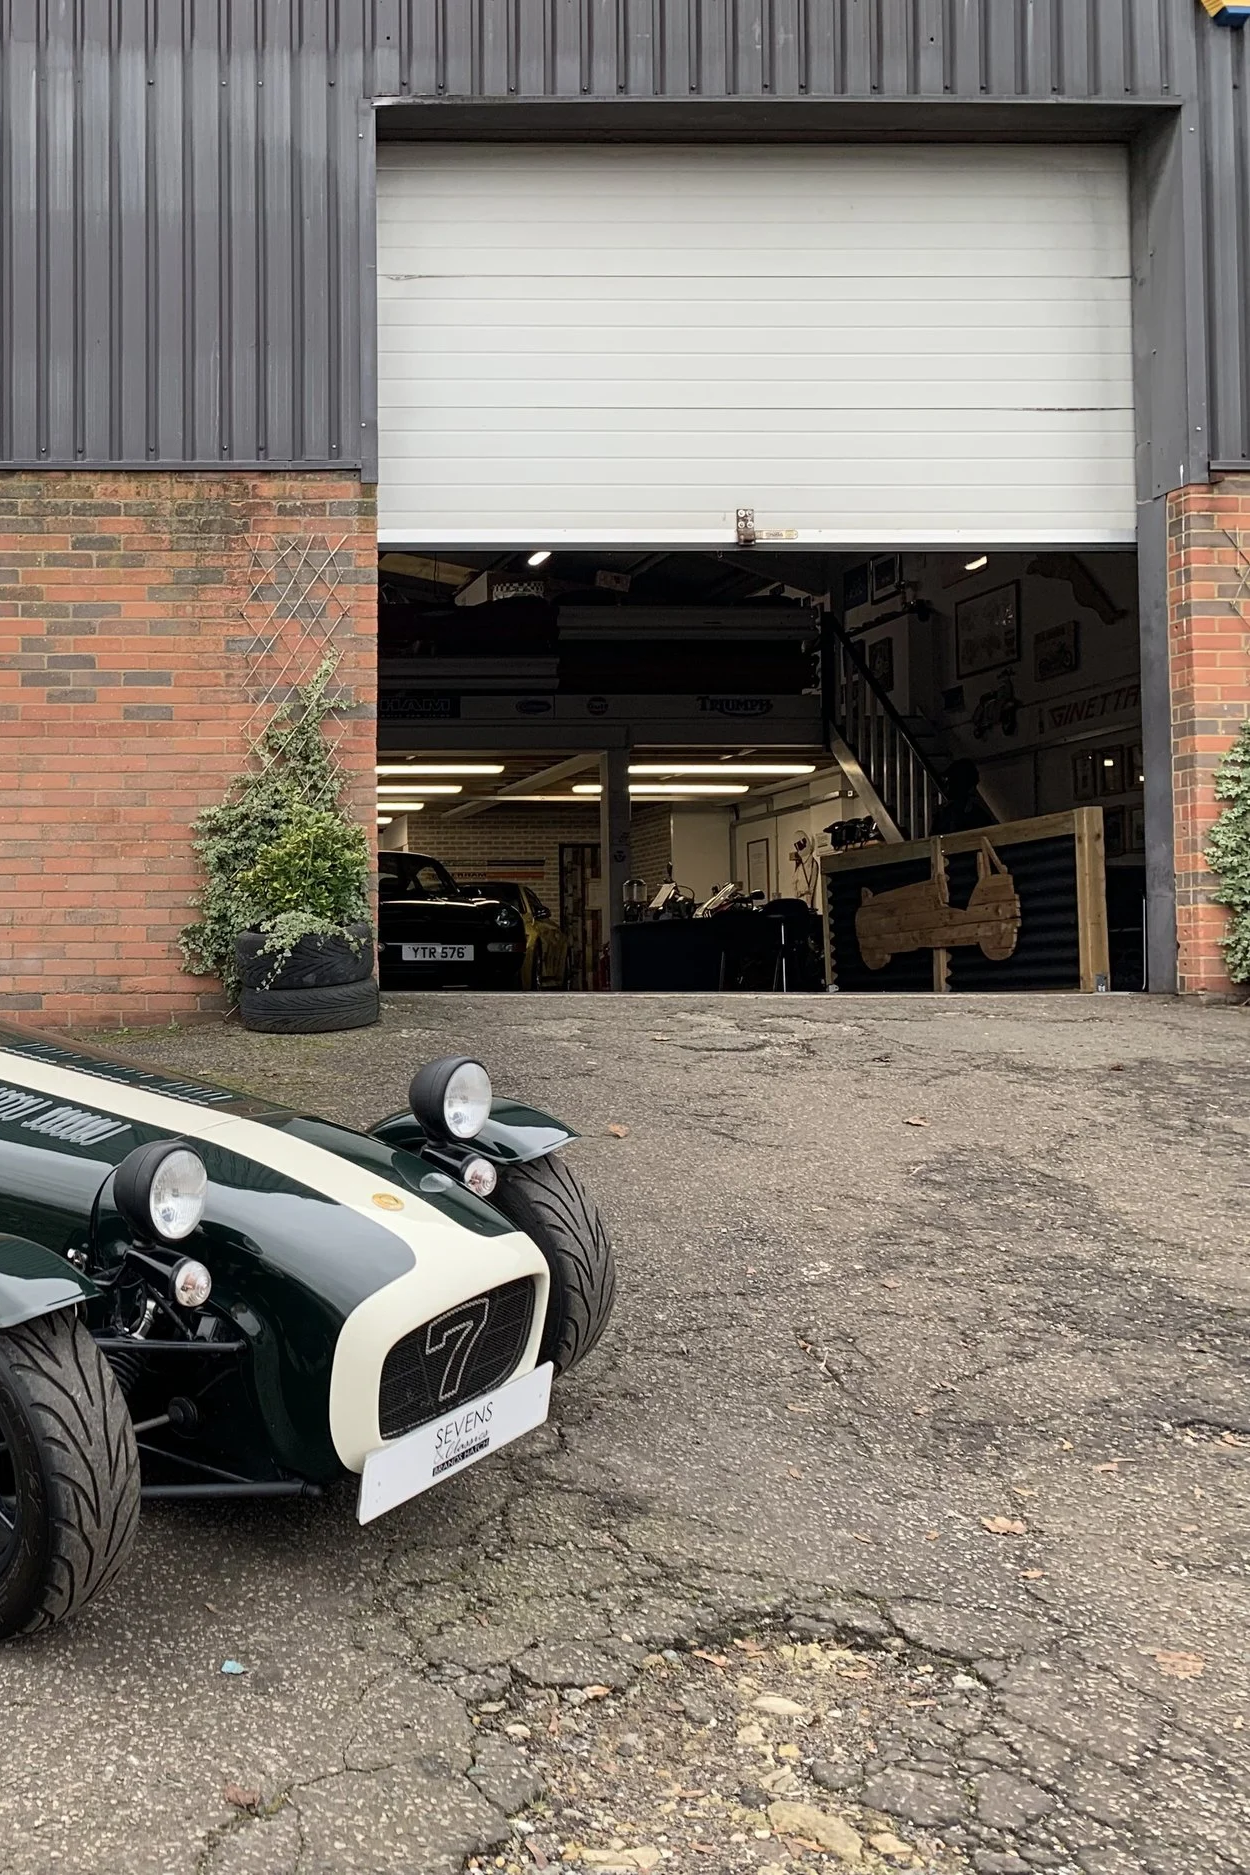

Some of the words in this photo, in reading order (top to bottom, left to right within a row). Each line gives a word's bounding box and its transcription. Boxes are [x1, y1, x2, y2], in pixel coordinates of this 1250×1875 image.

[697, 695, 774, 713] TRIUMPH
[1049, 684, 1140, 728] GINETTA
[411, 947, 437, 959] YTR
[440, 947, 465, 959] 576
[425, 1298, 489, 1401] 7
[435, 1401, 493, 1449] SEVENS
[433, 1451, 463, 1475] BRANDS
[463, 1438, 490, 1460] HATCH
[445, 1429, 489, 1459] Classics
